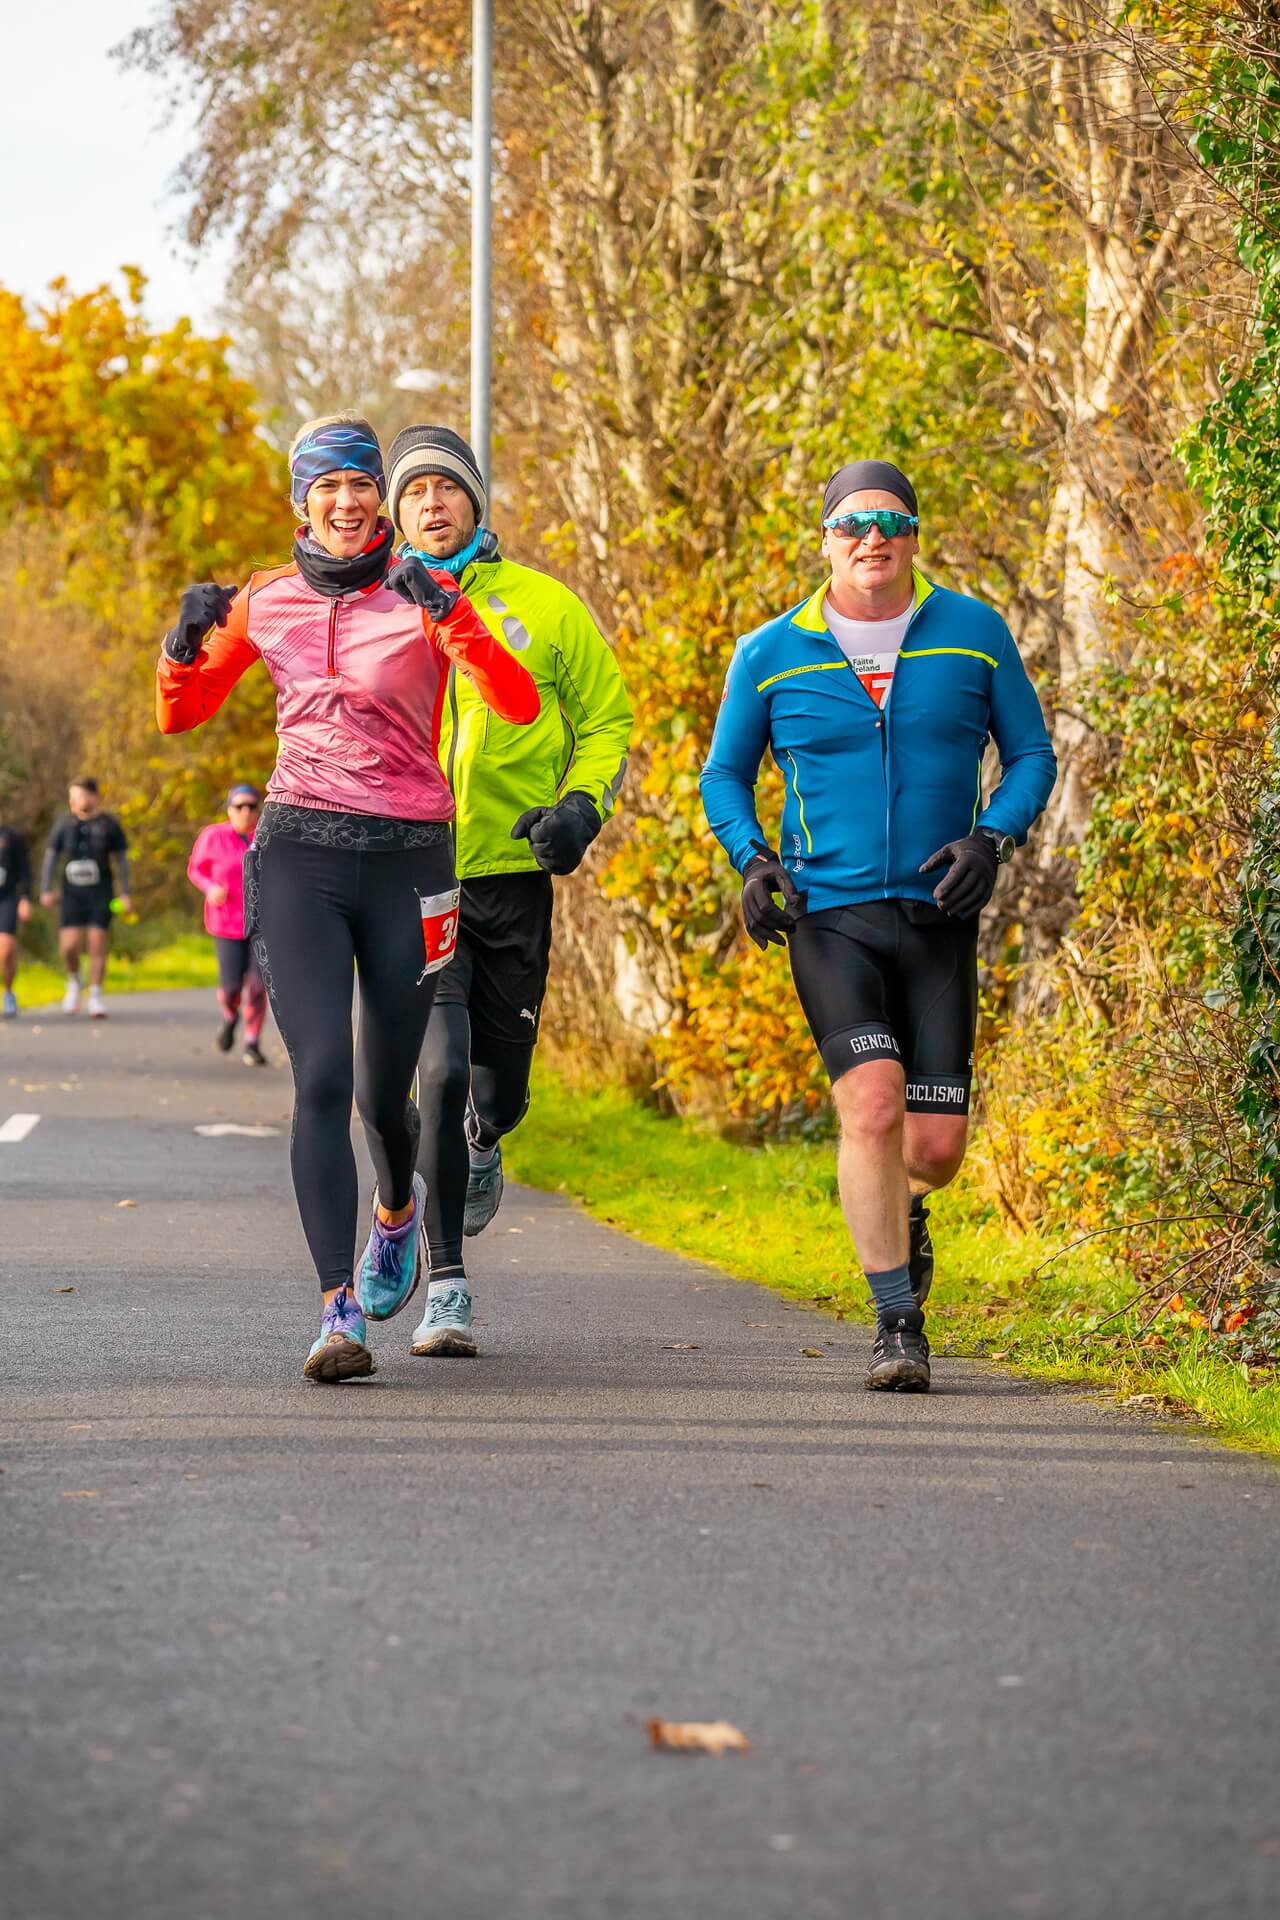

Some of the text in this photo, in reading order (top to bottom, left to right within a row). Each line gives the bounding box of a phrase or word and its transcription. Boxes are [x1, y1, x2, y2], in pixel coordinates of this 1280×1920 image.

[853, 664, 881, 672] reland
[438, 916, 458, 951] 3
[850, 1033, 893, 1054] GENCO
[905, 1084, 965, 1104] CICLISMO
